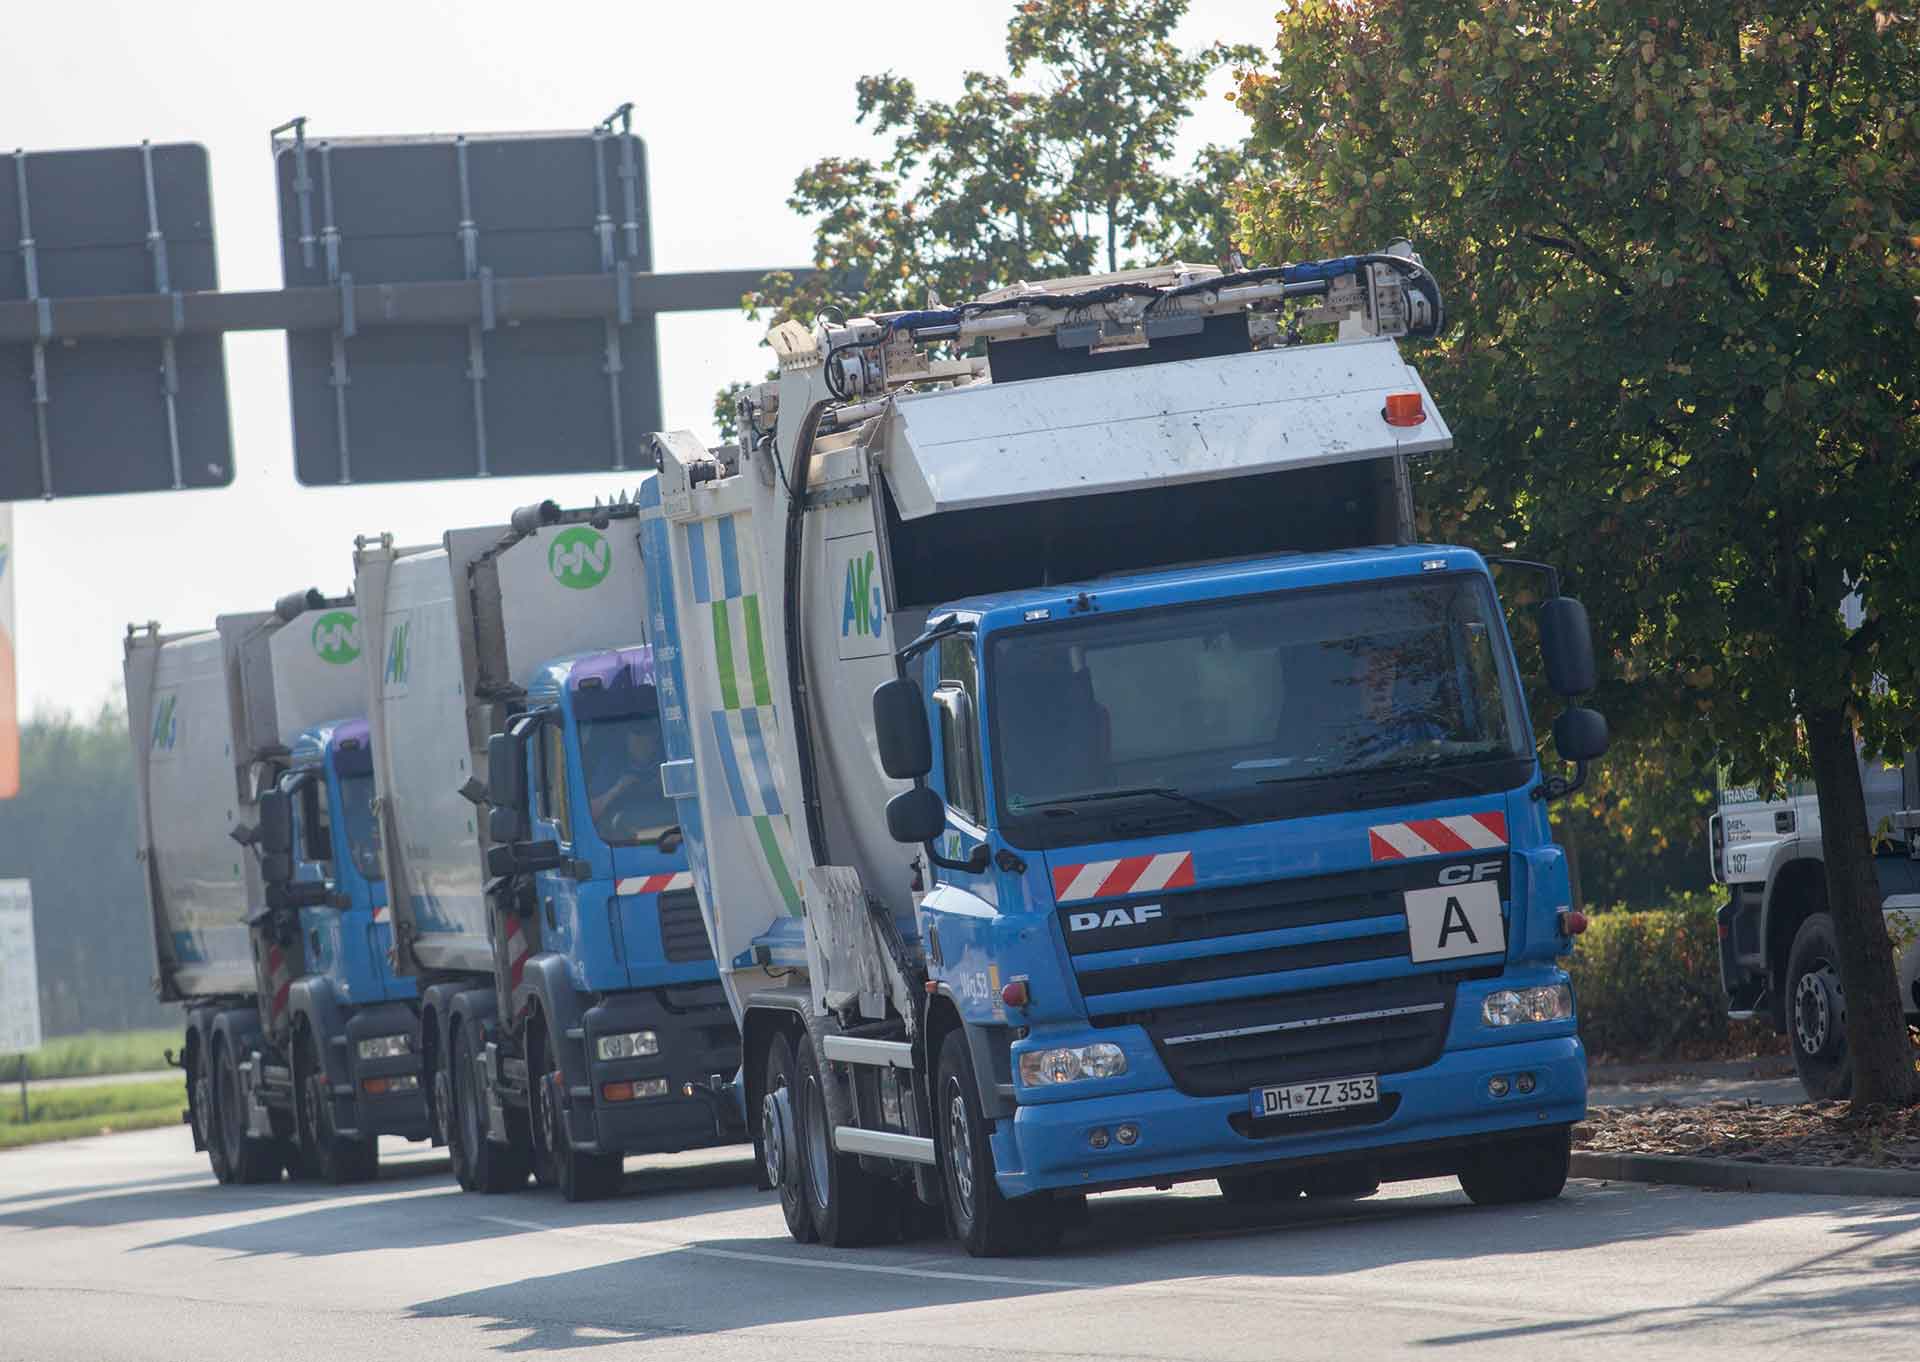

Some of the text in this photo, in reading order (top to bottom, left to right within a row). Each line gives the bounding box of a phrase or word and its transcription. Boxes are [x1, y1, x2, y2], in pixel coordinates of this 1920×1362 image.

[841, 551, 883, 638] AWG
[1438, 861, 1503, 886] CF
[1069, 904, 1163, 932] DAF
[1437, 896, 1480, 948] A
[1264, 1089, 1293, 1112] DH
[1304, 1084, 1333, 1107] ZZ
[1336, 1079, 1376, 1103] 353
